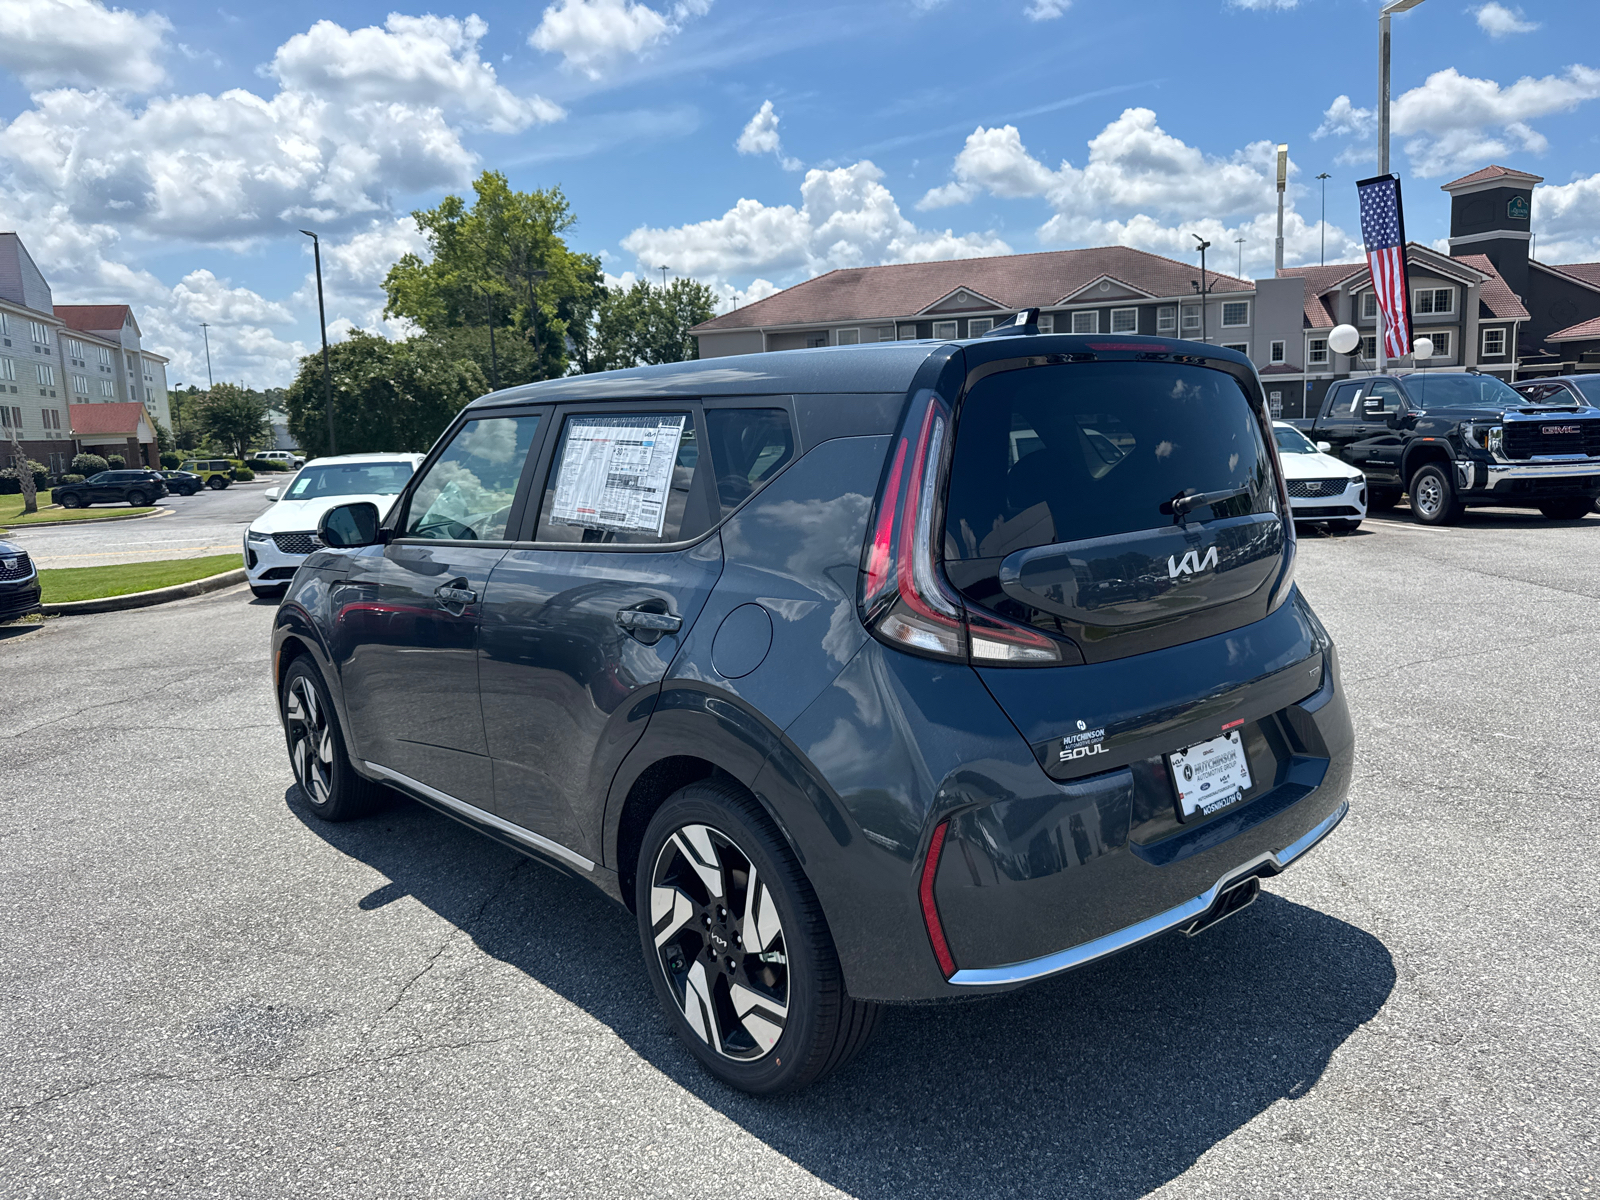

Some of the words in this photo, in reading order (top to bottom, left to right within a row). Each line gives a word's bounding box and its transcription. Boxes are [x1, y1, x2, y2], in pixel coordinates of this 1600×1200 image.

[1542, 425, 1580, 434] GMC
[1168, 546, 1218, 578] KIA
[1063, 729, 1105, 745] HUTCHINSON
[1065, 740, 1091, 750] AUTOMOTIVE
[1060, 744, 1110, 761] SOUL
[1194, 749, 1237, 775] HUTCHINSON
[1197, 766, 1224, 782] AUTOMOTIVE
[1223, 760, 1237, 773] GROUP
[1203, 794, 1236, 816] HUTCHINSON
